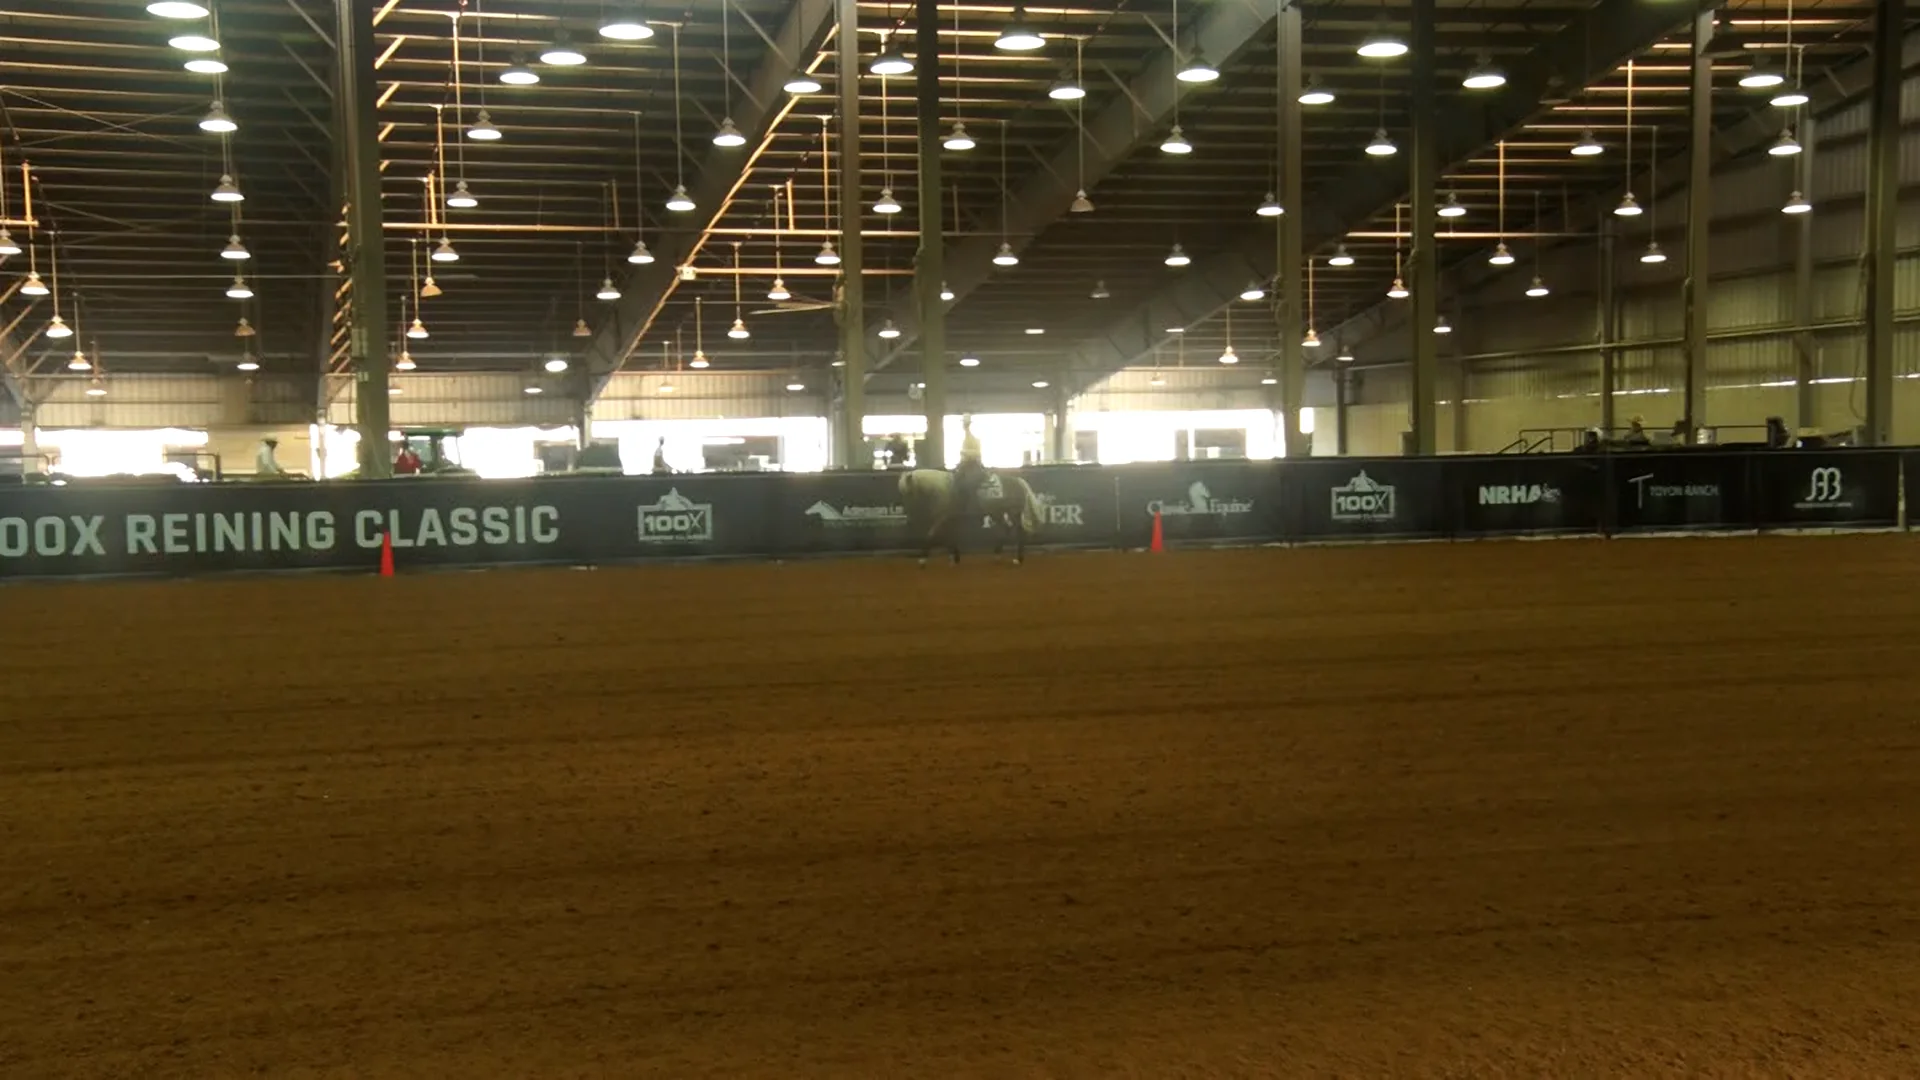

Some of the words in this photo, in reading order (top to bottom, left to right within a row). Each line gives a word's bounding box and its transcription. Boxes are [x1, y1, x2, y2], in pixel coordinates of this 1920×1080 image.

[1336, 491, 1388, 512] 100X
[1479, 485, 1541, 504] NRHA
[126, 511, 335, 555] REINING
[355, 505, 559, 548] CLASSIC
[644, 511, 704, 532] 100X
